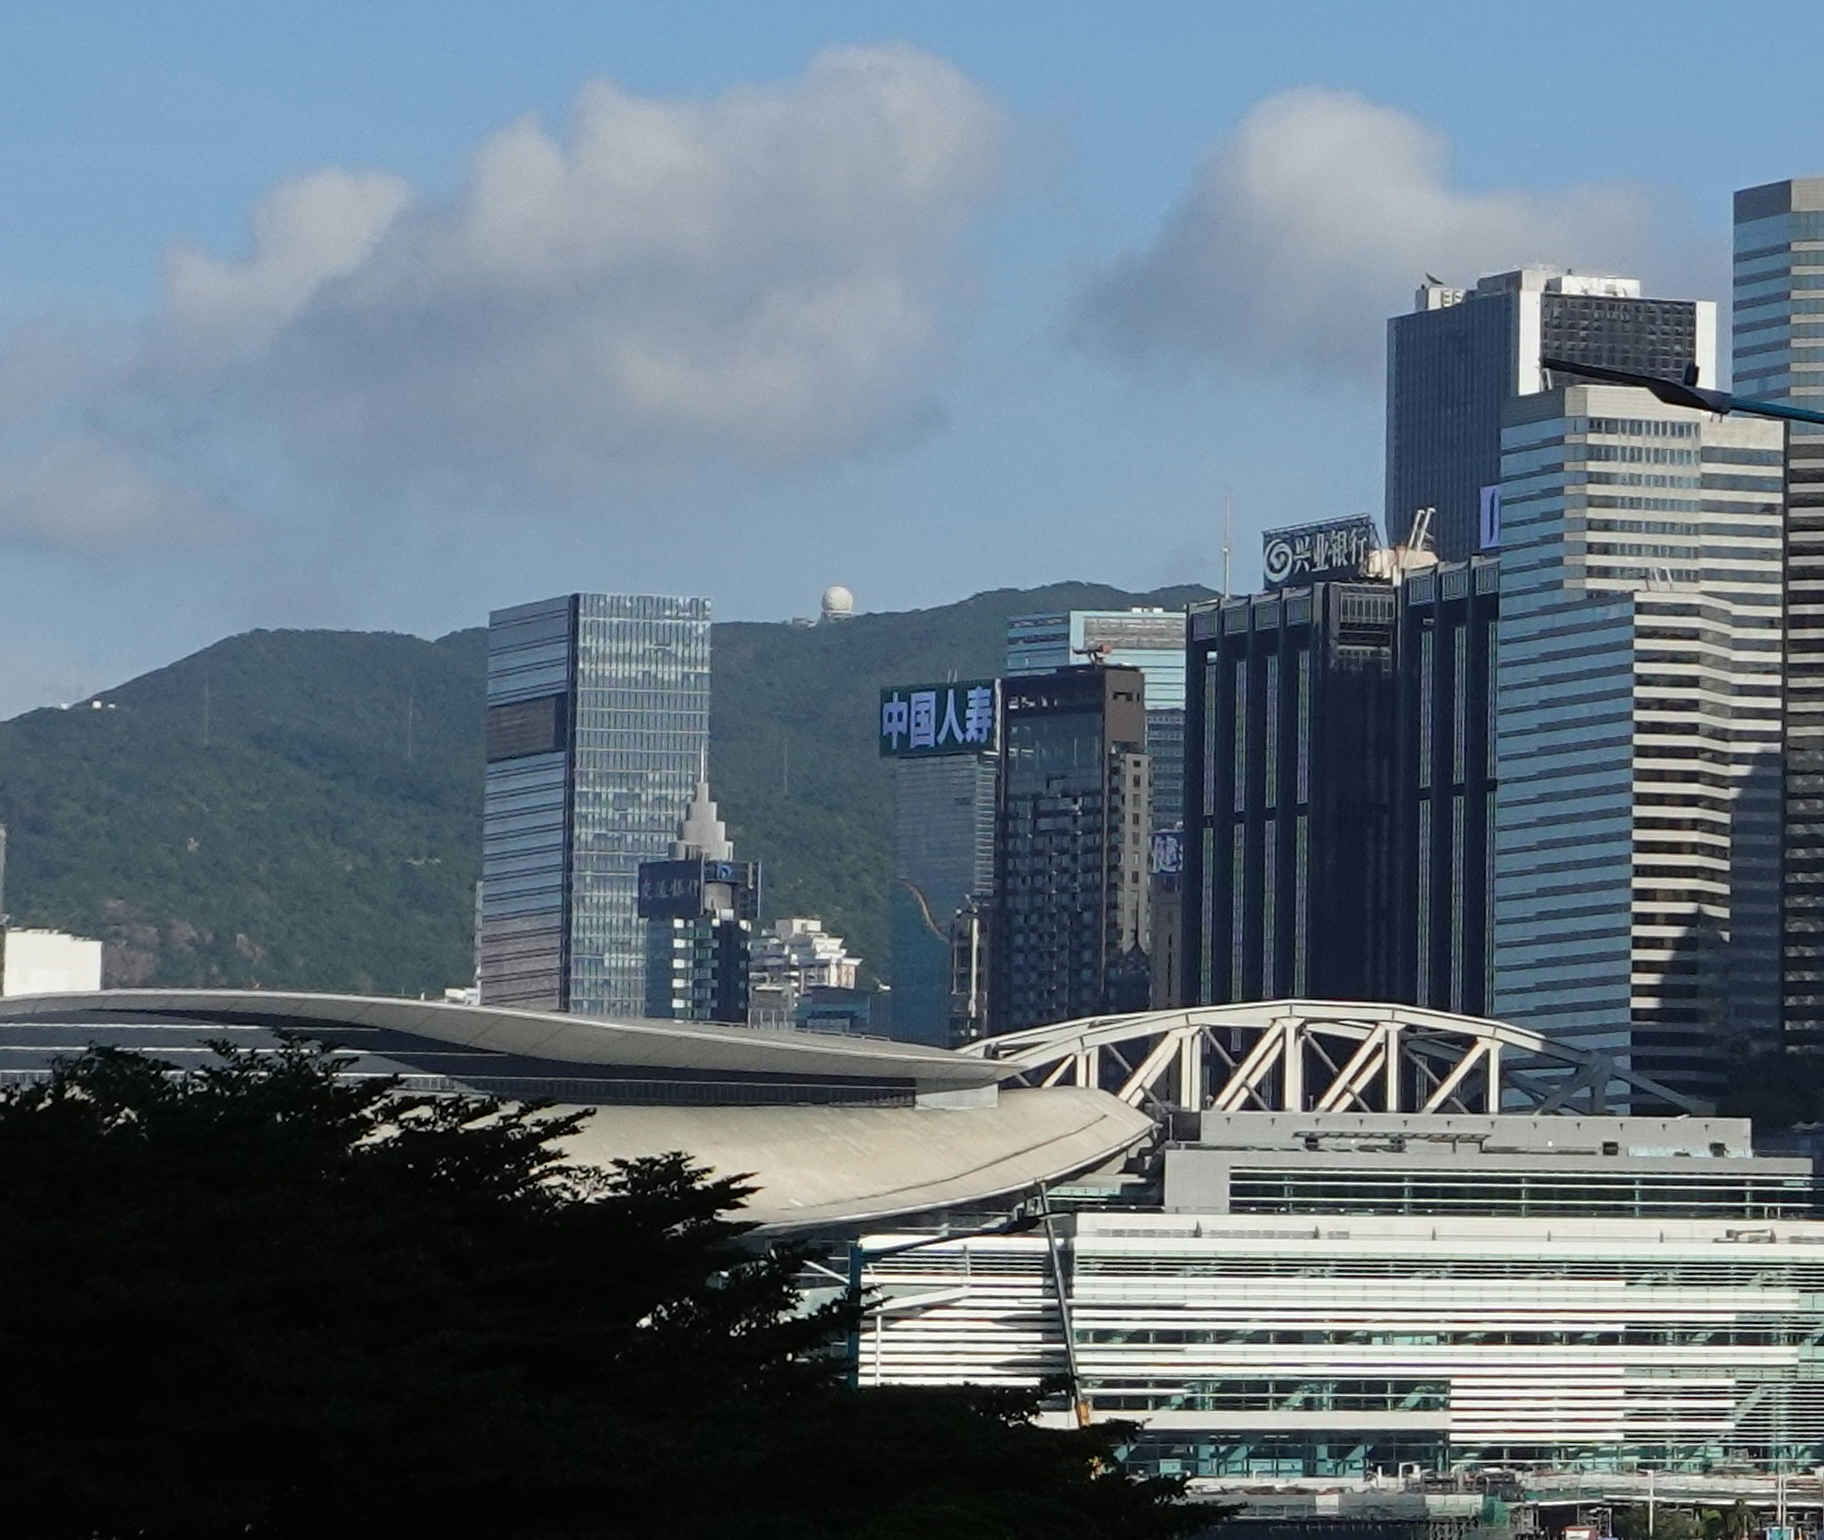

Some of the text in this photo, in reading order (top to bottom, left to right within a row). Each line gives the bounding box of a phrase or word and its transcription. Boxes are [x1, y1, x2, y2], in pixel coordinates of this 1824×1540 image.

[1292, 526, 1368, 575] 兴业银行
[882, 686, 993, 750] 中国人寿
